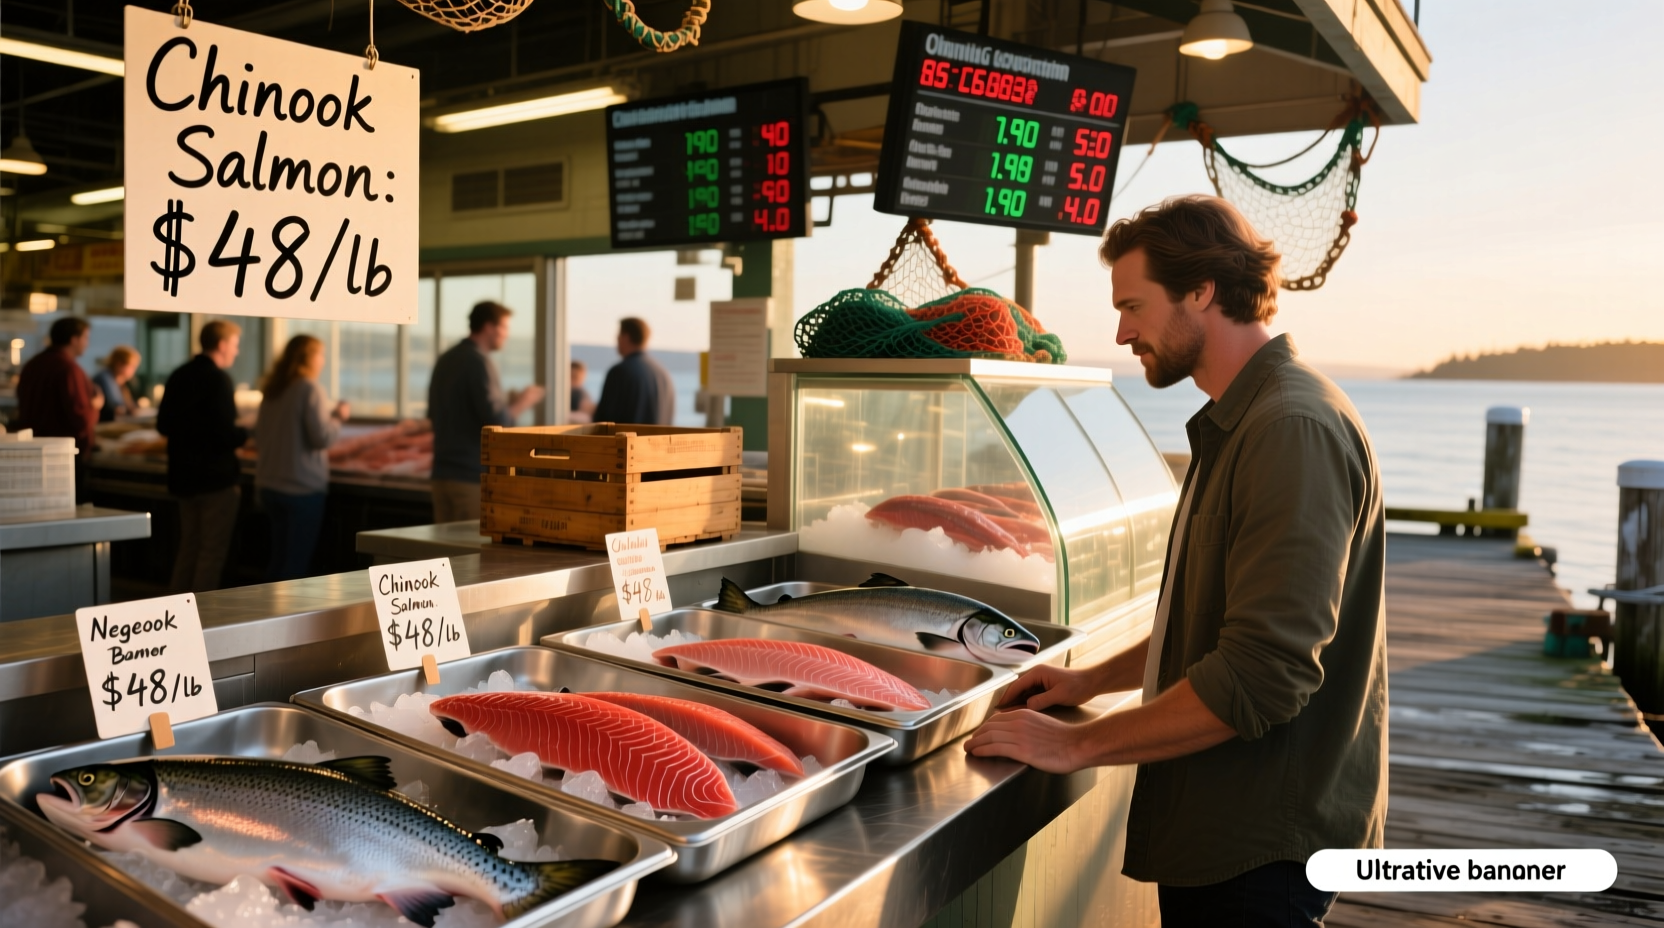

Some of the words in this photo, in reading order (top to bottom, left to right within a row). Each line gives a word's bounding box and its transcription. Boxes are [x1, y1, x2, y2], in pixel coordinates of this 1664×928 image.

[145, 37, 375, 133] Chinook
[996, 116, 1040, 149] 1.90
[168, 124, 396, 203] Salmon:
[1068, 162, 1106, 192] 5.0
[984, 187, 1027, 218] 1.90
[150, 199, 393, 302] $48/lb
[379, 571, 440, 596] Chinook
[91, 610, 178, 643] Negeook
[388, 616, 460, 651] $48/lb
[102, 668, 202, 712] $48/lb
